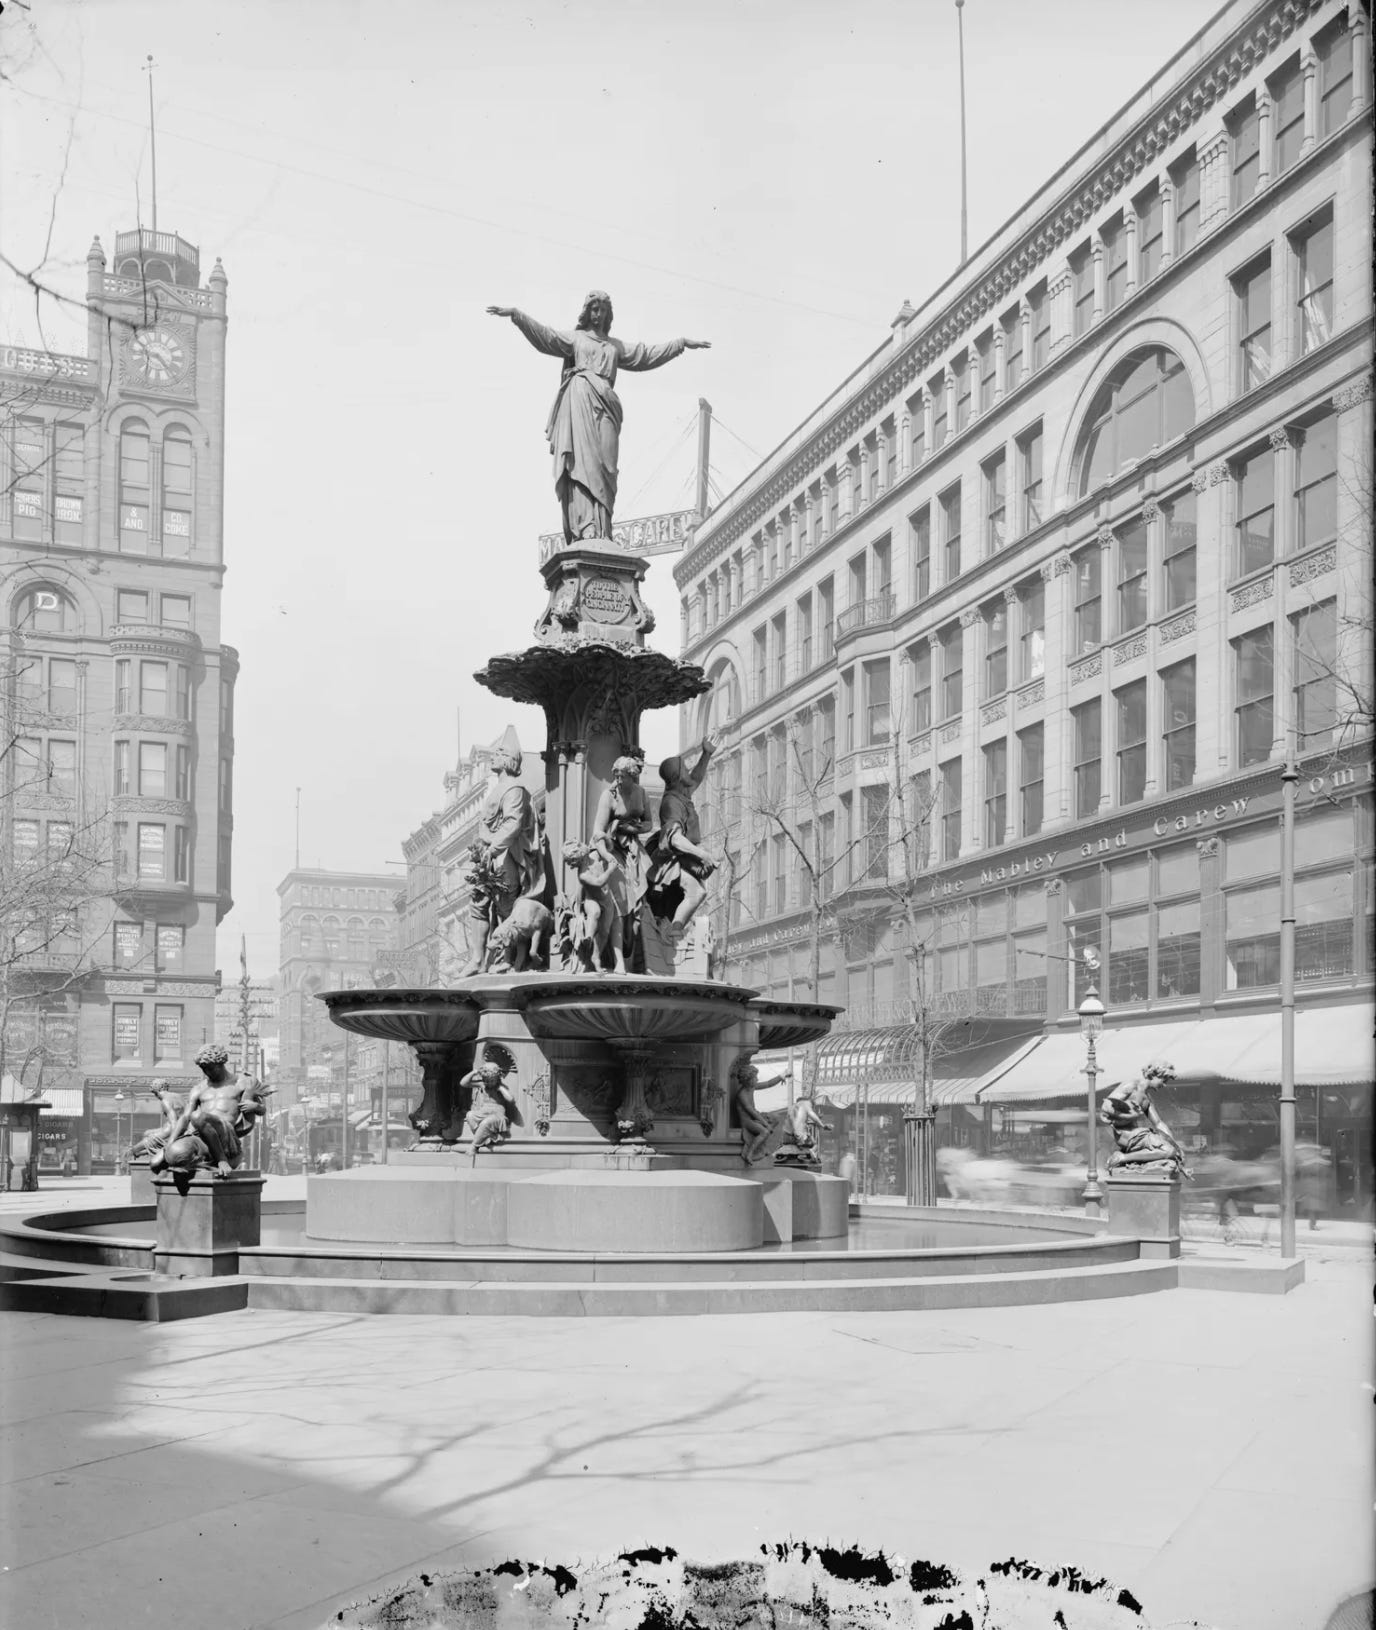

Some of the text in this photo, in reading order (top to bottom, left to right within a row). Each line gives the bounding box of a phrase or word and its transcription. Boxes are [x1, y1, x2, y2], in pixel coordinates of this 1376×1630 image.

[124, 517, 143, 530] AND
[980, 850, 1059, 885] Mabley
[1080, 828, 1127, 857] and
[1153, 796, 1252, 837] Carew
[37, 1132, 67, 1141] CIGARS
